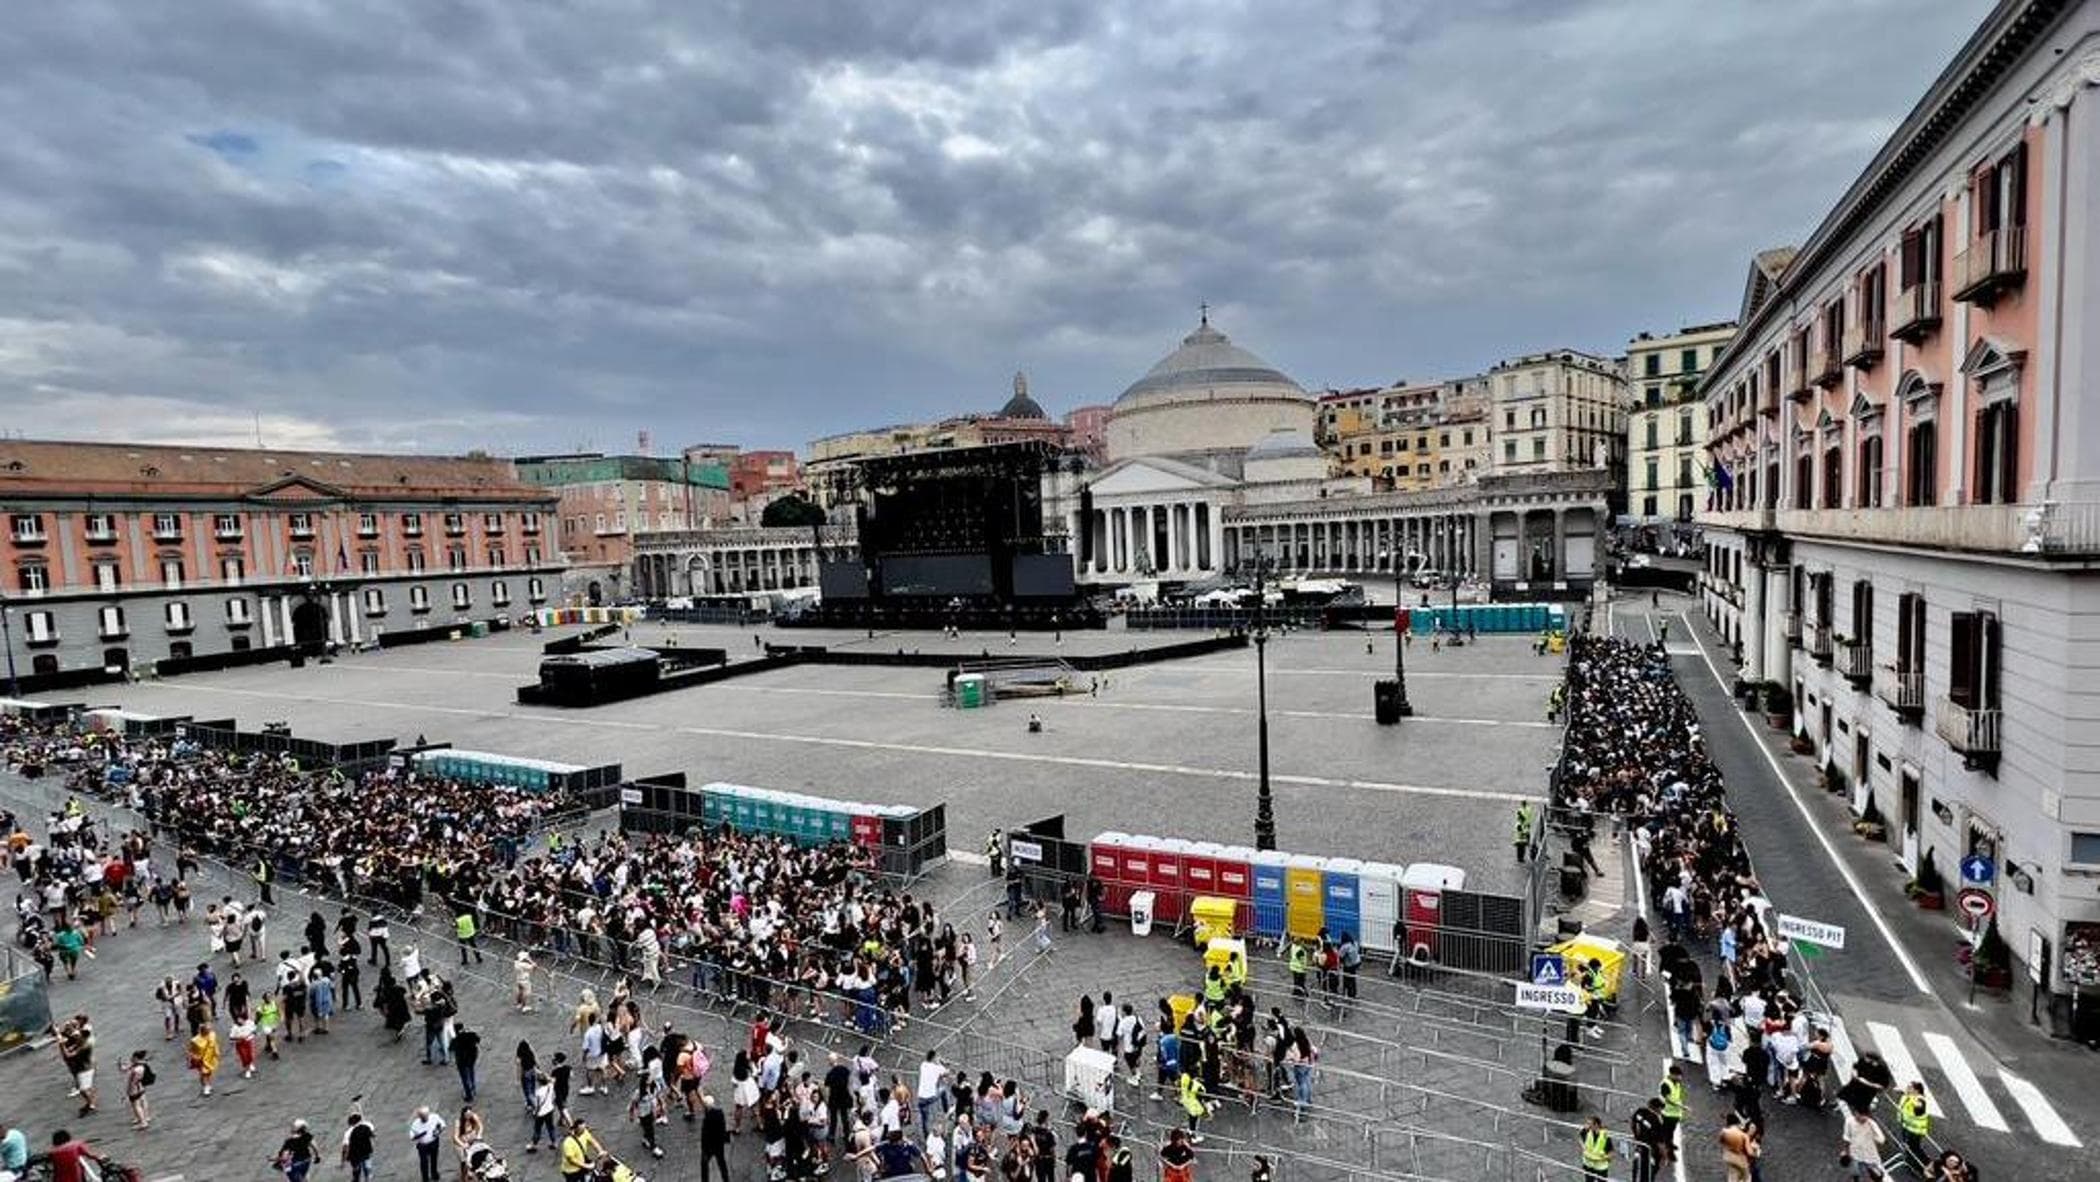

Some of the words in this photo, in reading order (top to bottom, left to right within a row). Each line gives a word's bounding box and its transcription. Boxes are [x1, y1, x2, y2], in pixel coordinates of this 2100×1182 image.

[1781, 921, 1824, 939] INGRESSO
[1827, 930, 1841, 941] PIT
[1520, 989, 1576, 1005] INGRESSO
